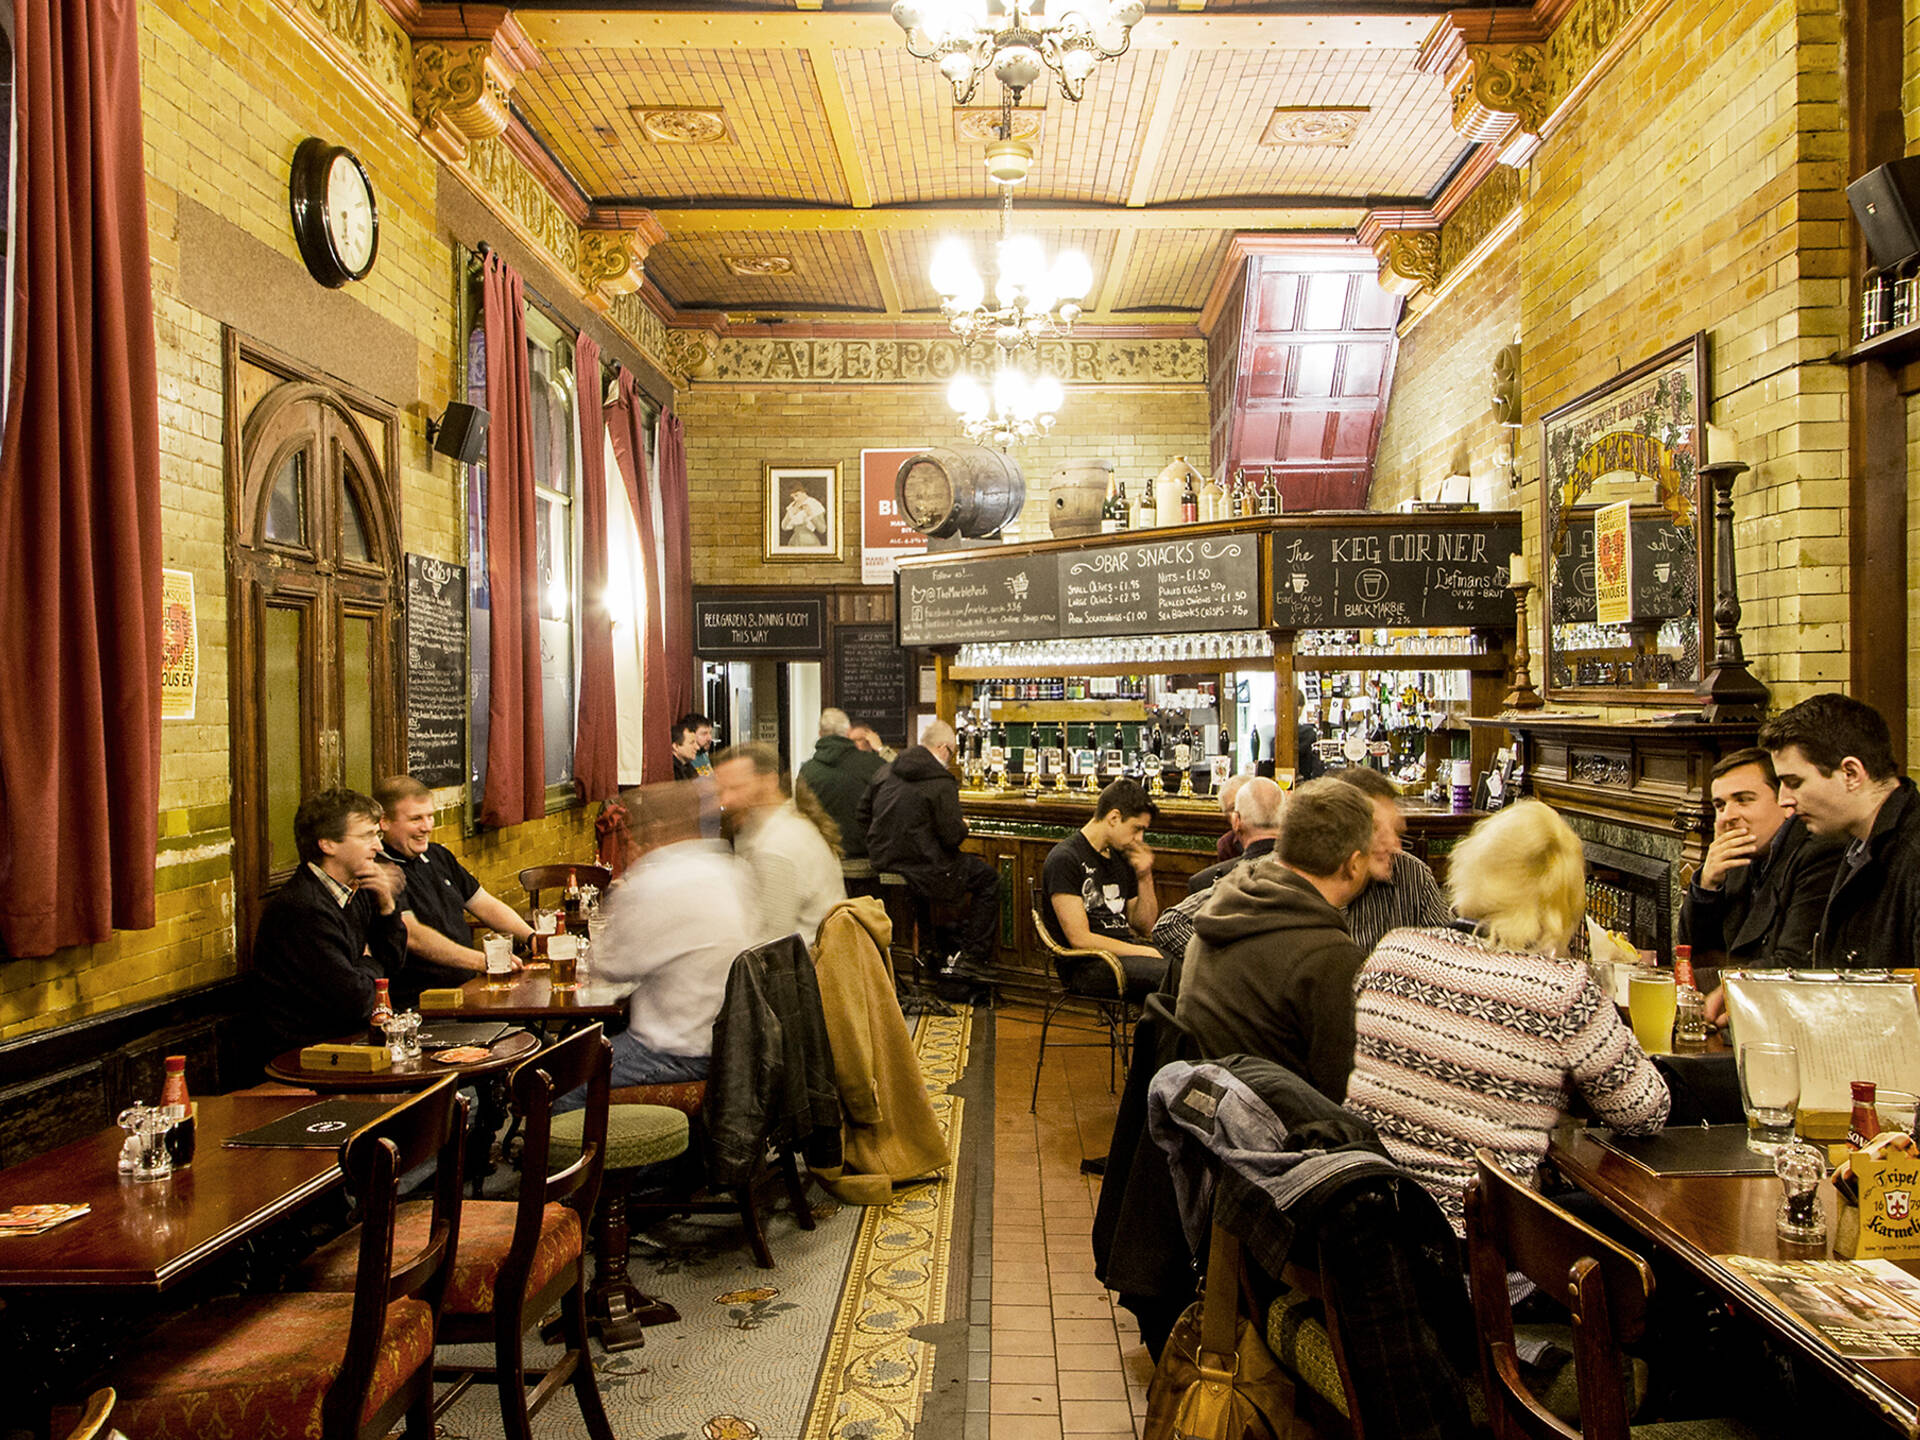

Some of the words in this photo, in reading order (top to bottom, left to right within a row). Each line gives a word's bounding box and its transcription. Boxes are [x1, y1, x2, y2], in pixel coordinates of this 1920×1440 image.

[762, 340, 872, 379] ALE
[1286, 538, 1315, 563] The
[1332, 535, 1382, 564] KEG
[1389, 534, 1488, 563] CORNER
[1104, 552, 1128, 573] BAR
[1137, 543, 1194, 568] SNACKS
[1186, 568, 1210, 581] £1.50
[1434, 567, 1490, 590] Liefmans
[1221, 590, 1247, 603] £1.50
[1301, 592, 1323, 607] Grey
[1483, 589, 1504, 599] BRUT
[1372, 602, 1406, 619] MARBLE
[748, 613, 758, 627] &
[759, 613, 784, 626] DINING
[786, 613, 808, 626] ROOM
[732, 630, 750, 643] THIS
[750, 630, 769, 642] WAY
[182, 672, 193, 687] EX
[1874, 1168, 1919, 1187] Tripel
[1874, 1201, 1884, 1212] 16
